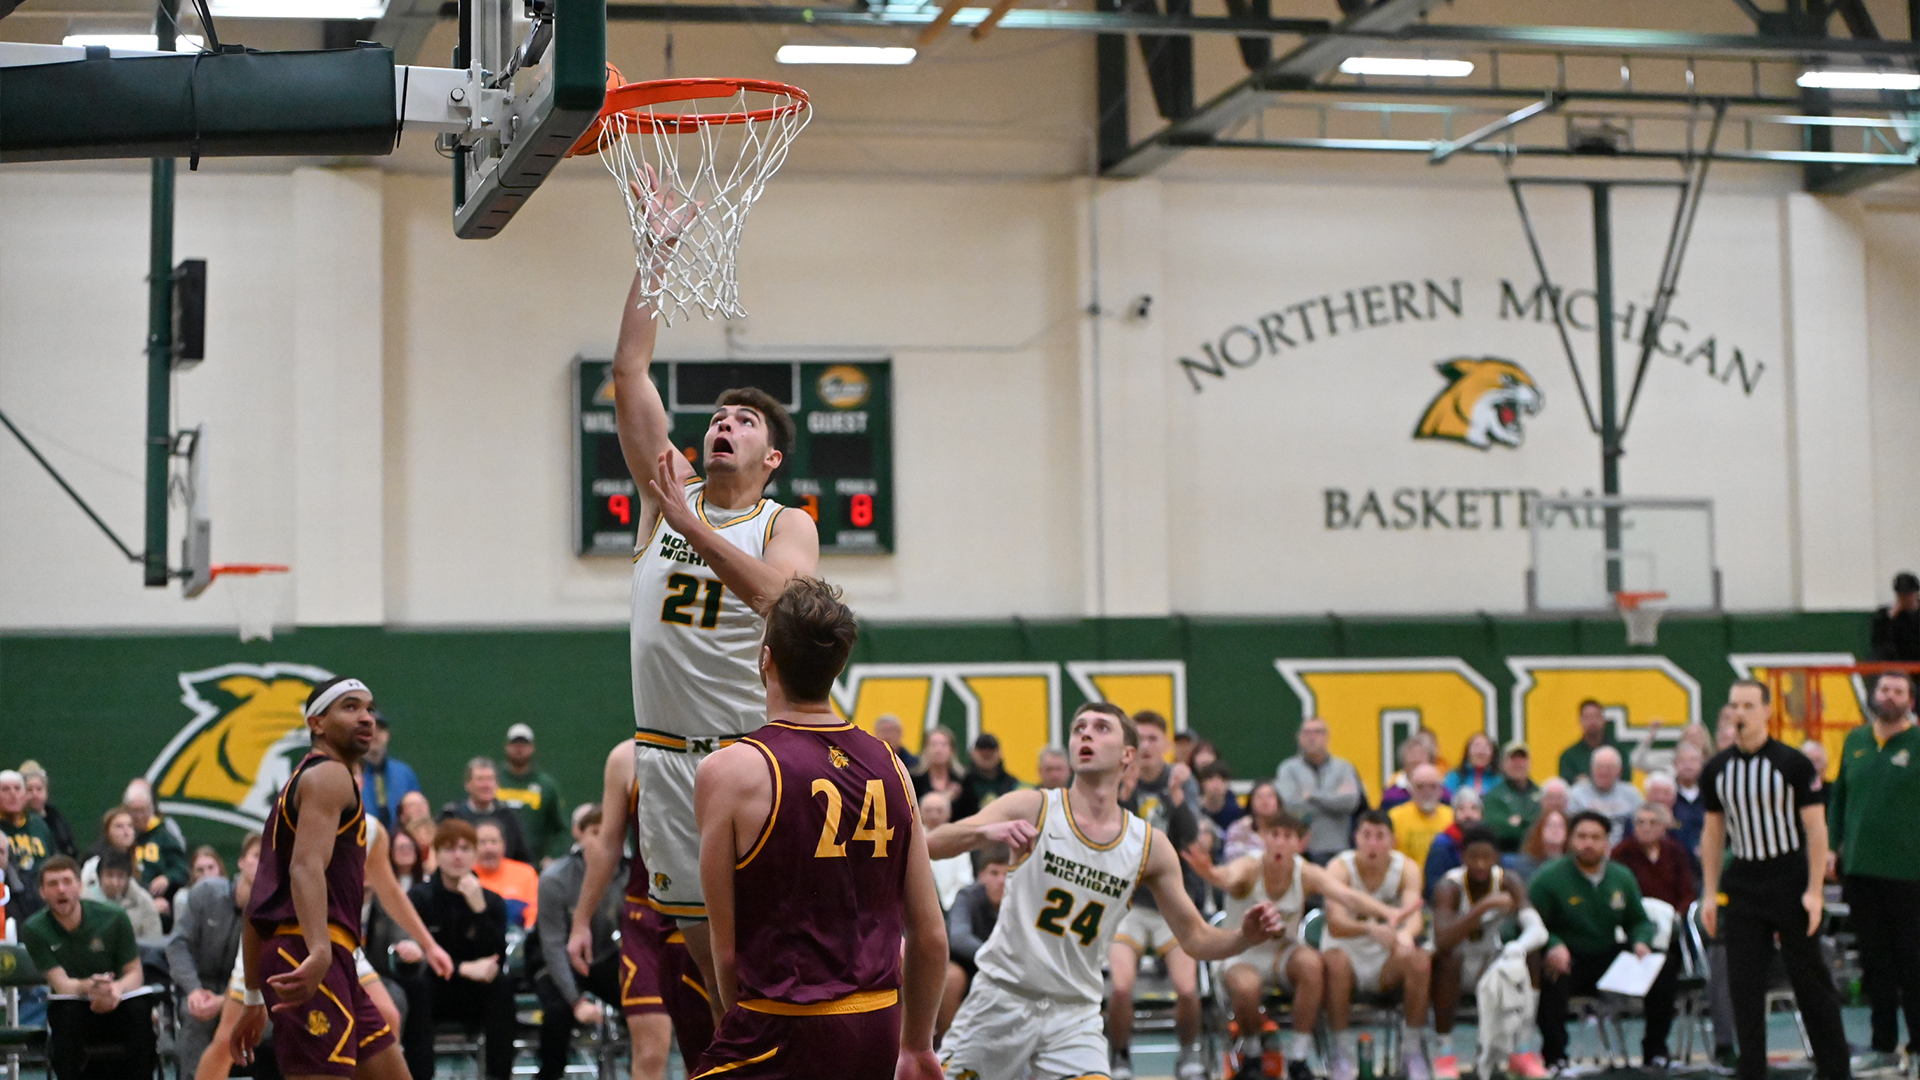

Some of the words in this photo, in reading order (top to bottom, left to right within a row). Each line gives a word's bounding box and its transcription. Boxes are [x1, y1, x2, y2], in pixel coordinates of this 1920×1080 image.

[1177, 277, 1463, 394] NORTHERN
[807, 411, 868, 433] GUEST
[608, 494, 631, 524] 9
[851, 493, 873, 527] 8
[1323, 487, 1634, 530] BASKETBAL
[660, 572, 725, 630] 21
[692, 738, 713, 753] N
[811, 778, 895, 858] 24
[1043, 850, 1130, 890] NORTHERN
[1044, 863, 1122, 899] MICHIGAN
[1036, 887, 1107, 946] 24
